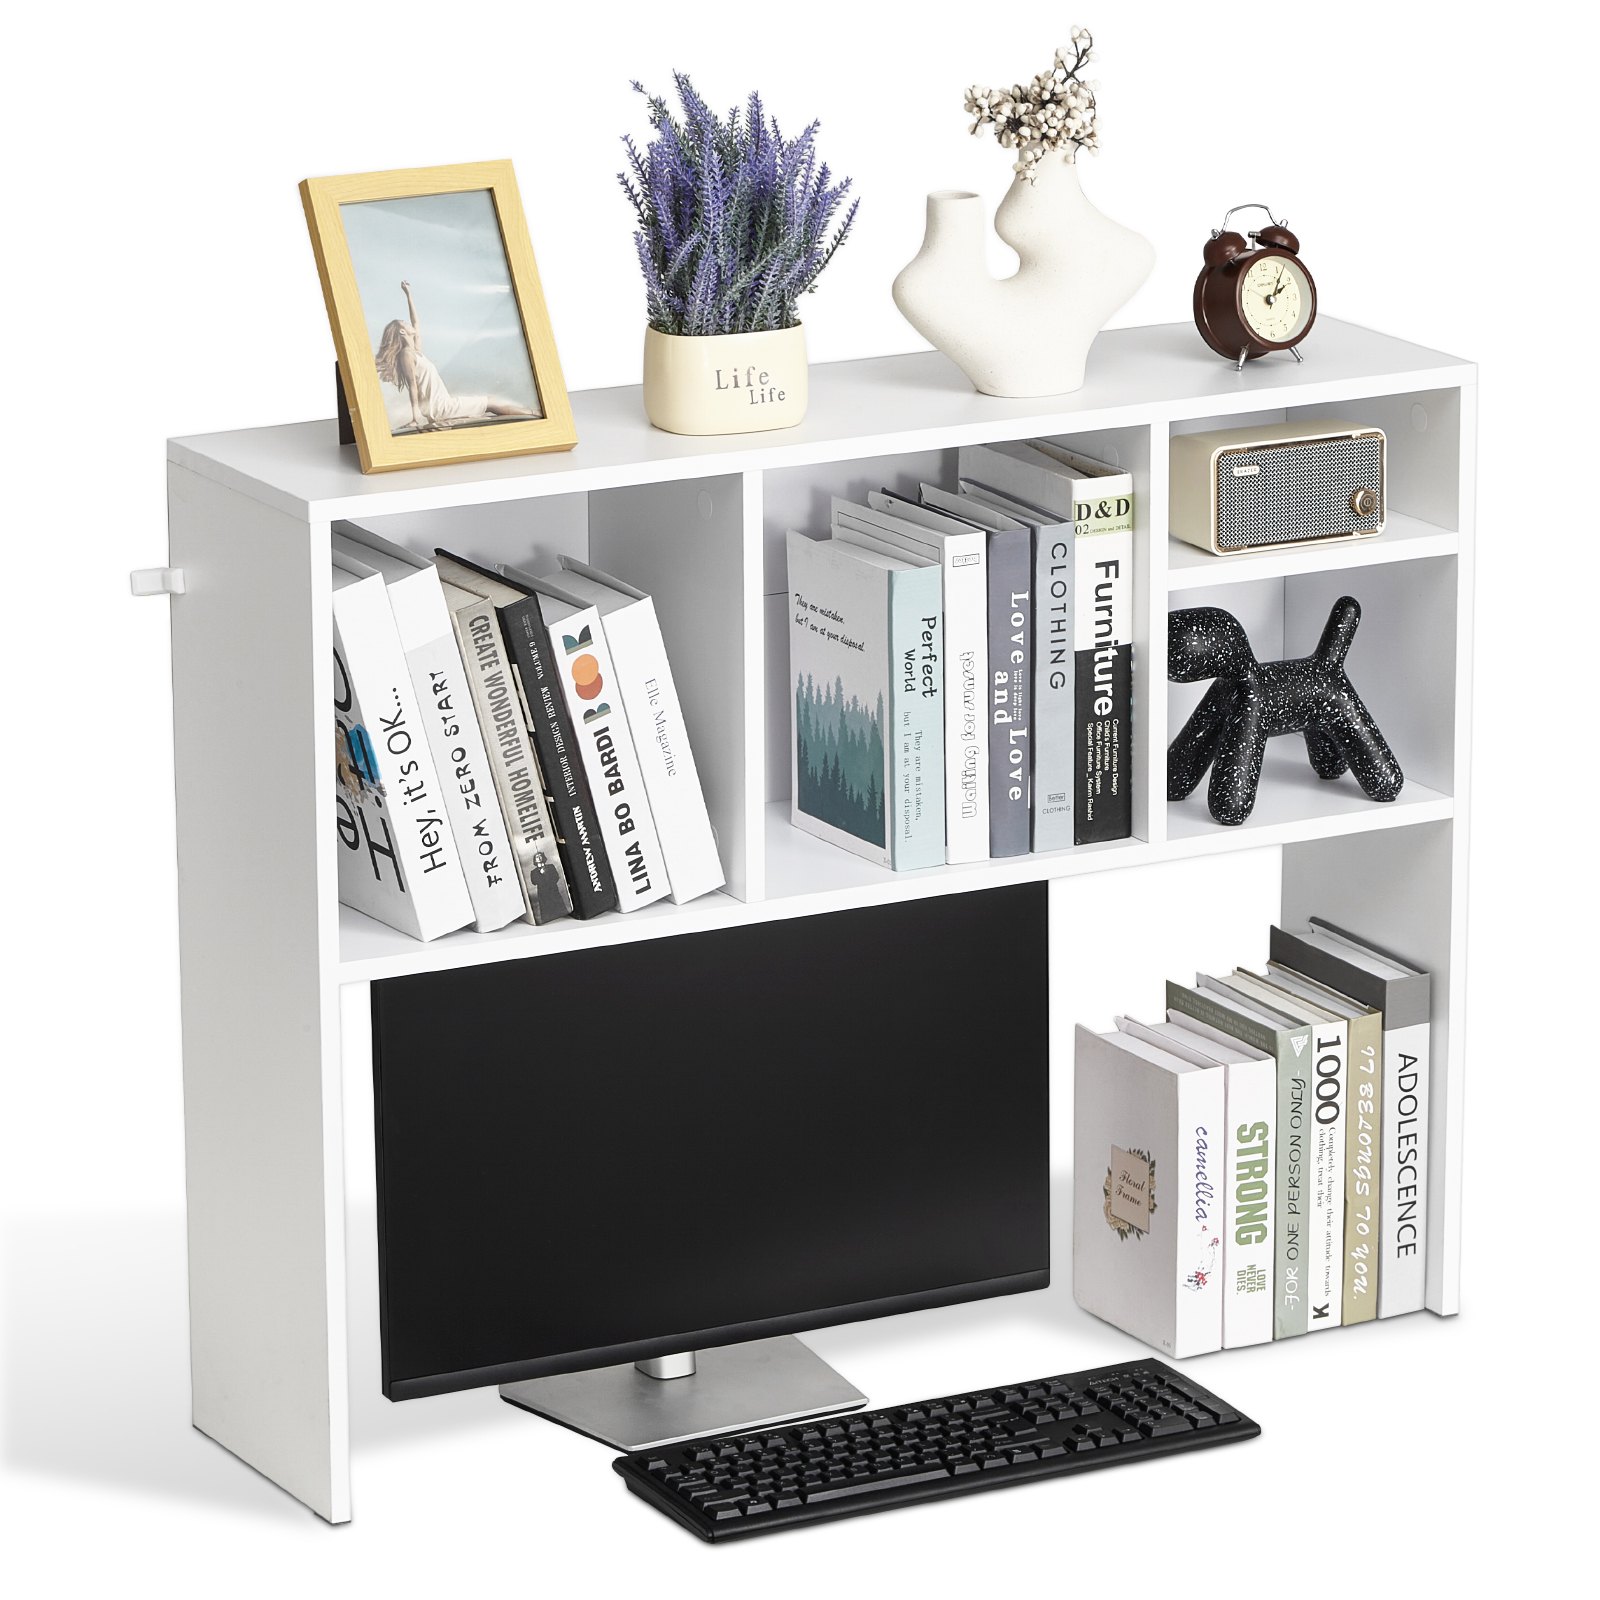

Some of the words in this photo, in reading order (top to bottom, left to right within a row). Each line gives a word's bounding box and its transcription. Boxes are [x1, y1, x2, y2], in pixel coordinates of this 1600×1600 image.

[715, 366, 770, 390] Life
[750, 387, 786, 405] Life
[1075, 503, 1092, 521] D
[1095, 500, 1112, 519] &
[1115, 498, 1130, 517] D
[1075, 524, 1090, 535] 02
[795, 593, 808, 611] They
[1050, 542, 1067, 690] CLOTHING
[468, 614, 501, 672] CREATE
[1010, 590, 1029, 664] Love
[1094, 559, 1119, 716] Furniture
[529, 648, 544, 680] VOLUME
[904, 648, 916, 692] World
[921, 616, 937, 698] Perfect
[960, 651, 975, 710] sunset
[994, 671, 1012, 725] and
[379, 687, 412, 755] OK...
[428, 671, 460, 737] START
[483, 671, 525, 768] WONDERFUL
[540, 685, 557, 719] REVIEW
[903, 711, 911, 726] but
[550, 721, 566, 754] DESIGN
[645, 678, 660, 706] Elle
[653, 710, 677, 777] Magazine
[915, 730, 923, 751] They
[961, 713, 976, 741] for
[593, 726, 625, 796] BARDI
[903, 742, 909, 754] am
[904, 757, 910, 768] at
[1008, 727, 1028, 801] Love
[398, 760, 427, 806] it's
[451, 747, 482, 810] ZERO
[559, 755, 577, 797] INTERIOR
[961, 745, 980, 819] Waiting
[1095, 770, 1103, 794] System
[1111, 772, 1119, 795] Design
[507, 766, 545, 844] HOMELIFE
[915, 776, 923, 821] mistaken,
[1042, 805, 1071, 815] CLOTHING
[614, 802, 636, 836] BO
[904, 798, 912, 843] disposal.
[416, 809, 447, 874] Hey,
[472, 818, 503, 888] FROM
[624, 840, 652, 895] LINA
[1359, 1045, 1376, 1074] IT
[1315, 1035, 1342, 1124] 1000
[1316, 1128, 1326, 1165] clothing,
[1326, 1127, 1336, 1173] Completely
[1353, 1082, 1374, 1196] BELONGS
[1397, 1053, 1418, 1259] ADOLESCENCE
[1119, 1170, 1146, 1191] Floral
[1195, 1126, 1214, 1222] camellia
[1235, 1121, 1269, 1246] STRONG
[1288, 1135, 1302, 1215] PERSON
[1317, 1167, 1325, 1186] treat
[1325, 1176, 1335, 1205] change
[1115, 1184, 1141, 1206] Frame
[1317, 1190, 1325, 1208] their
[1326, 1208, 1334, 1227] their
[1356, 1205, 1371, 1236] TO
[1287, 1222, 1299, 1261] ONE
[1325, 1230, 1333, 1262] attitude
[1236, 1270, 1246, 1295] DIES.
[1247, 1264, 1256, 1293] NEVER
[1257, 1269, 1266, 1292] LOVE
[1324, 1265, 1332, 1297] towards
